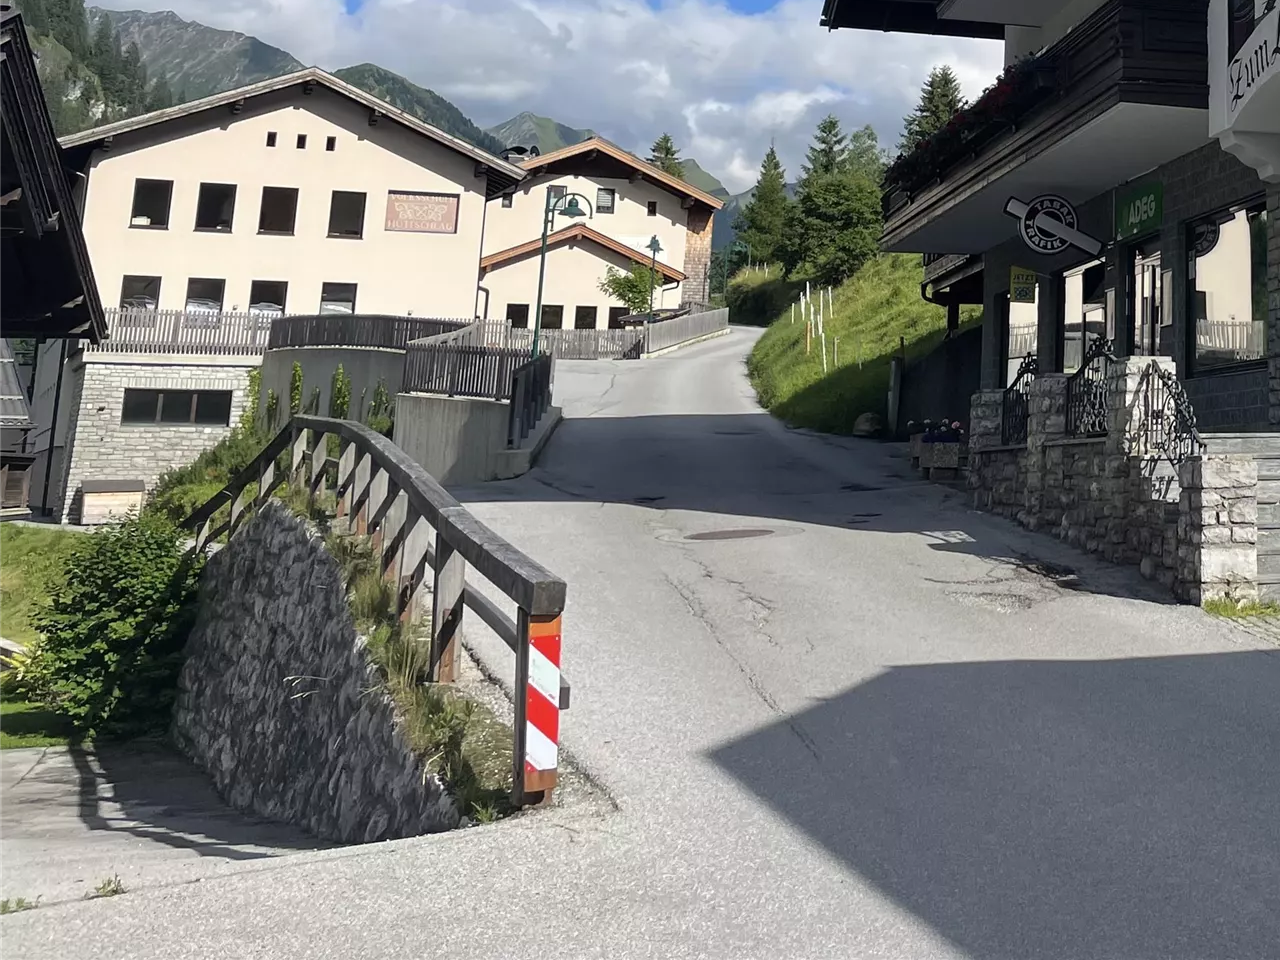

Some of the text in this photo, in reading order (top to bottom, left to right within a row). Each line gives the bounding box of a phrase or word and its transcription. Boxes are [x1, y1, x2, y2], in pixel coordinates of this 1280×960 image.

[1230, 39, 1269, 112] Zum
[1034, 200, 1074, 224] TABAK
[1128, 193, 1156, 227] ADEG
[1025, 219, 1062, 249] TRAFIK
